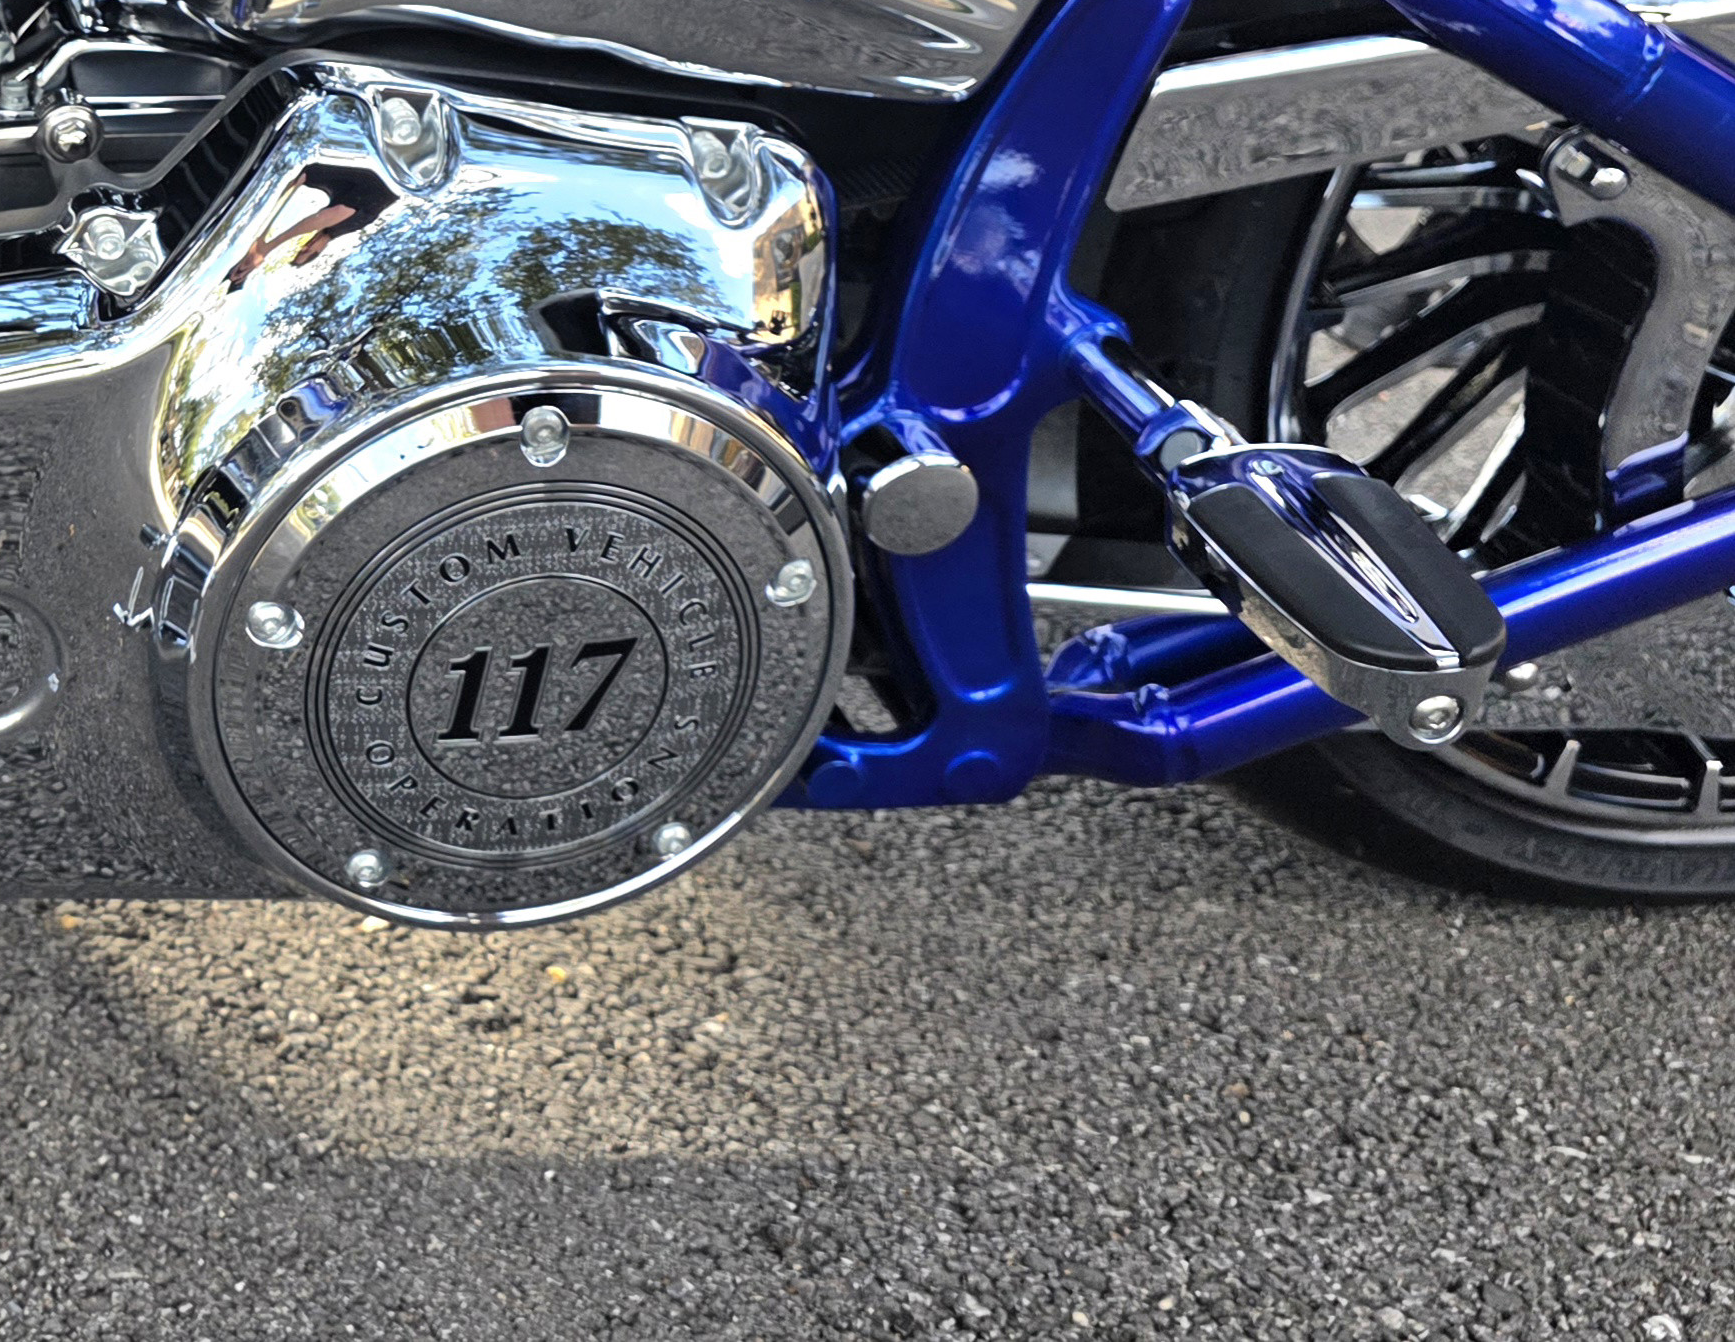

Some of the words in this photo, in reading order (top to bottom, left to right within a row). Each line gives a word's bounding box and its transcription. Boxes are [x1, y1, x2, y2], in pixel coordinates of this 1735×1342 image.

[355, 531, 521, 707] CUSTOM
[564, 525, 717, 679] VEHICLE
[435, 637, 639, 745] 117
[365, 717, 700, 837] OPERATIONS
